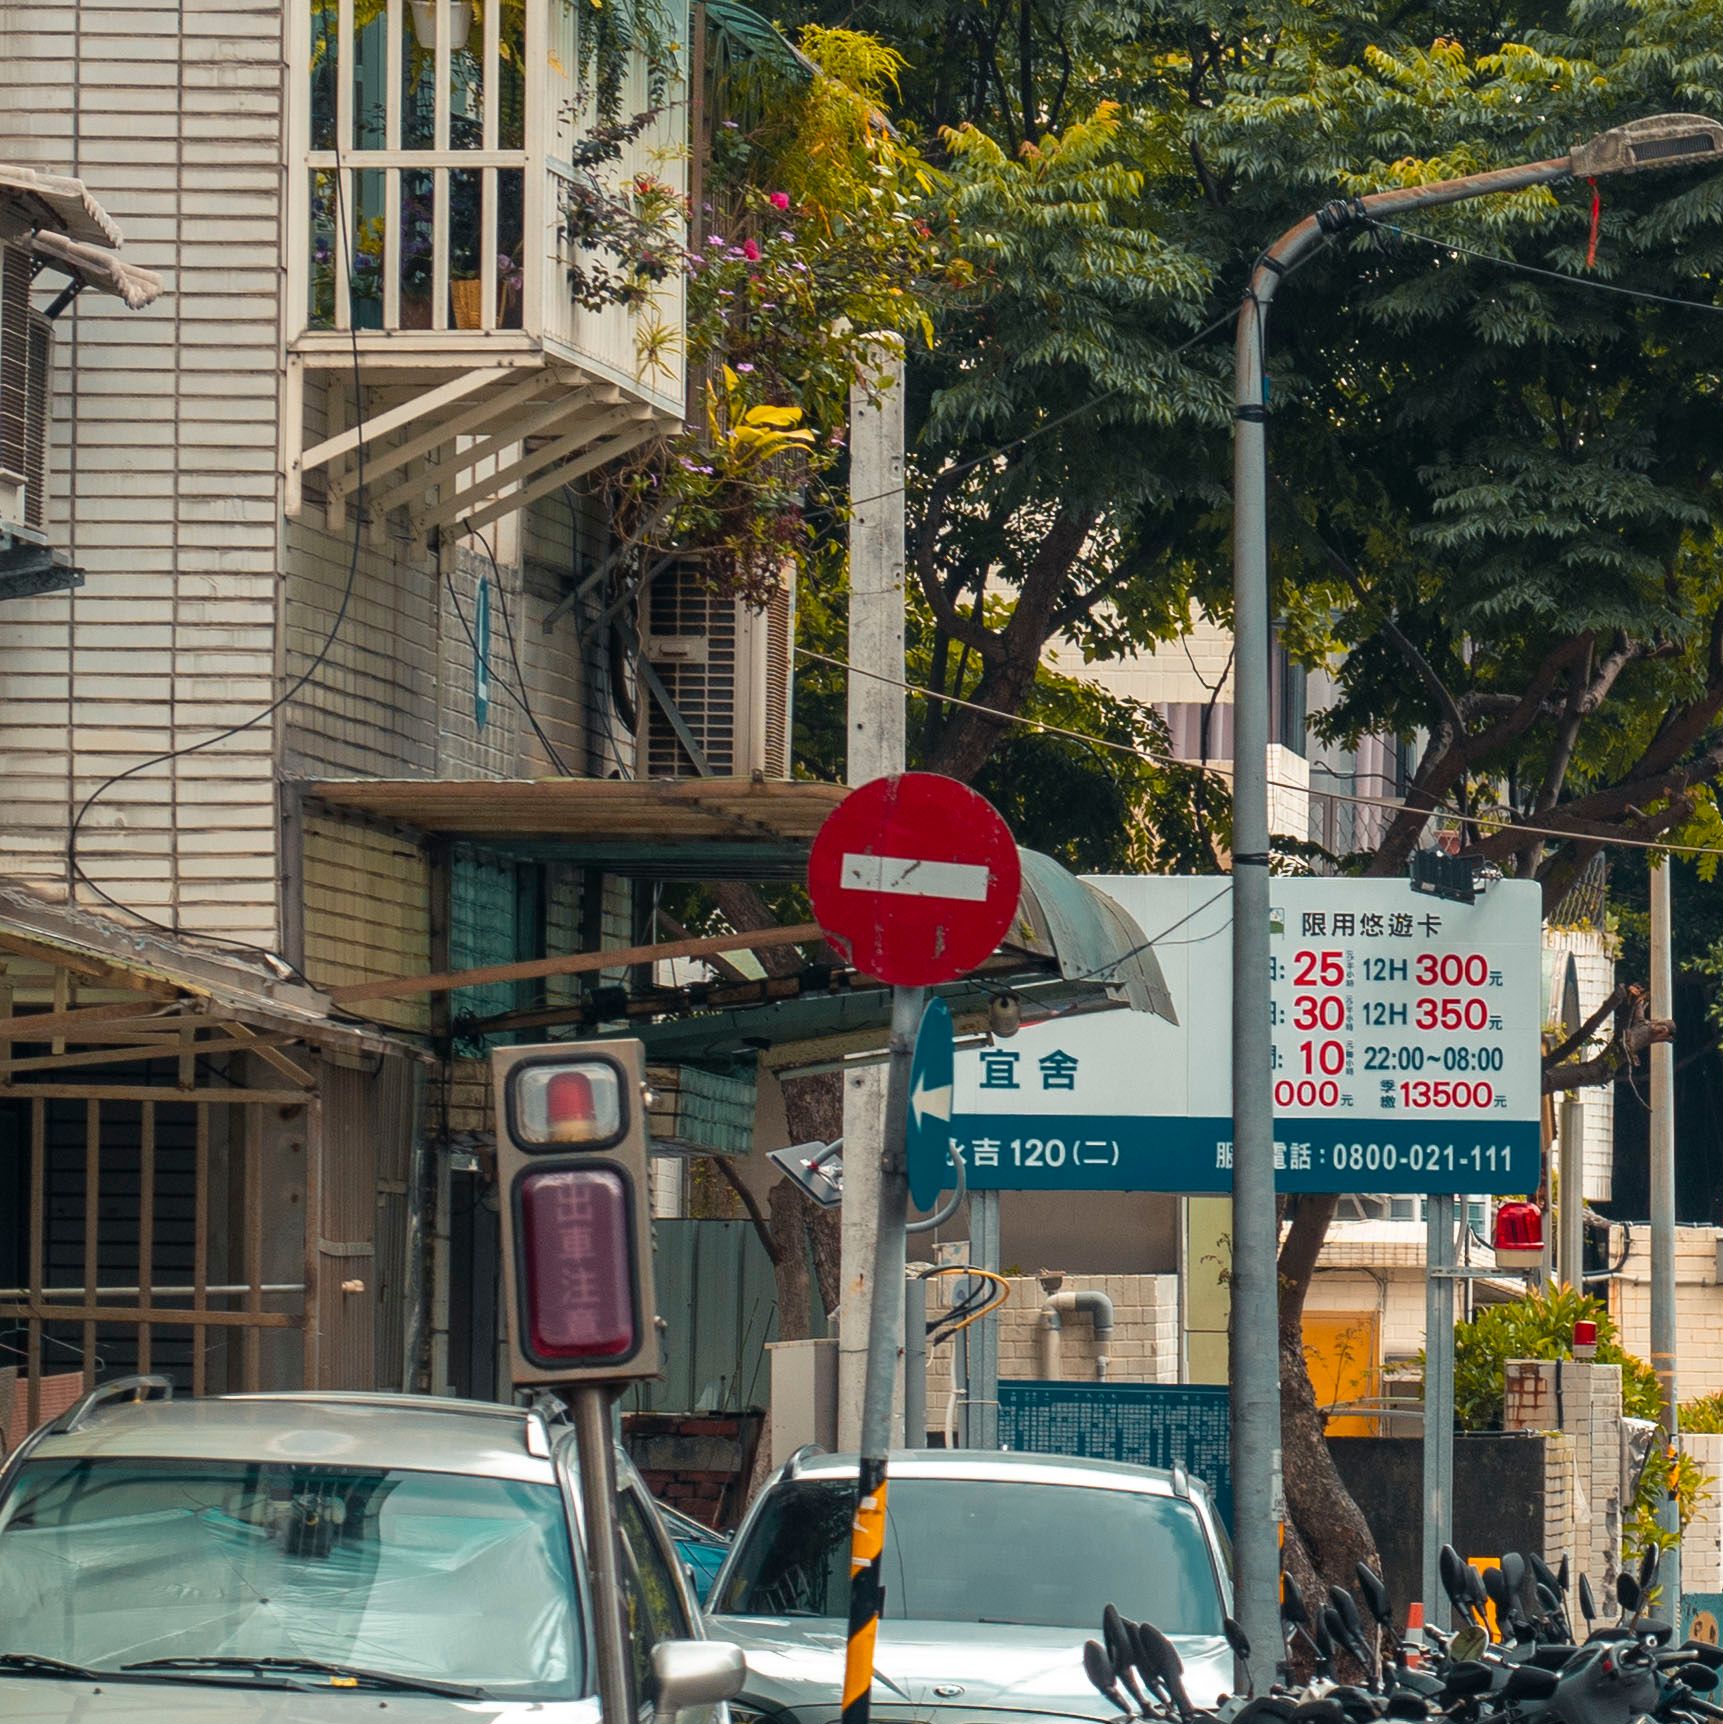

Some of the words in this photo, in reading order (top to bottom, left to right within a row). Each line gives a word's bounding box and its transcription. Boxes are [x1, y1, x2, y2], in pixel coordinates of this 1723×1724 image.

[1302, 912, 1443, 938] 限用悠遊卡
[1293, 951, 1345, 986] 25
[1363, 958, 1407, 981] 12H
[1293, 996, 1345, 1031] 30
[1363, 1003, 1407, 1025] 12H
[1300, 1040, 1345, 1075] 10
[1363, 1046, 1504, 1071] 22:00~08:00
[1333, 1144, 1511, 1171] 0800-021-111
